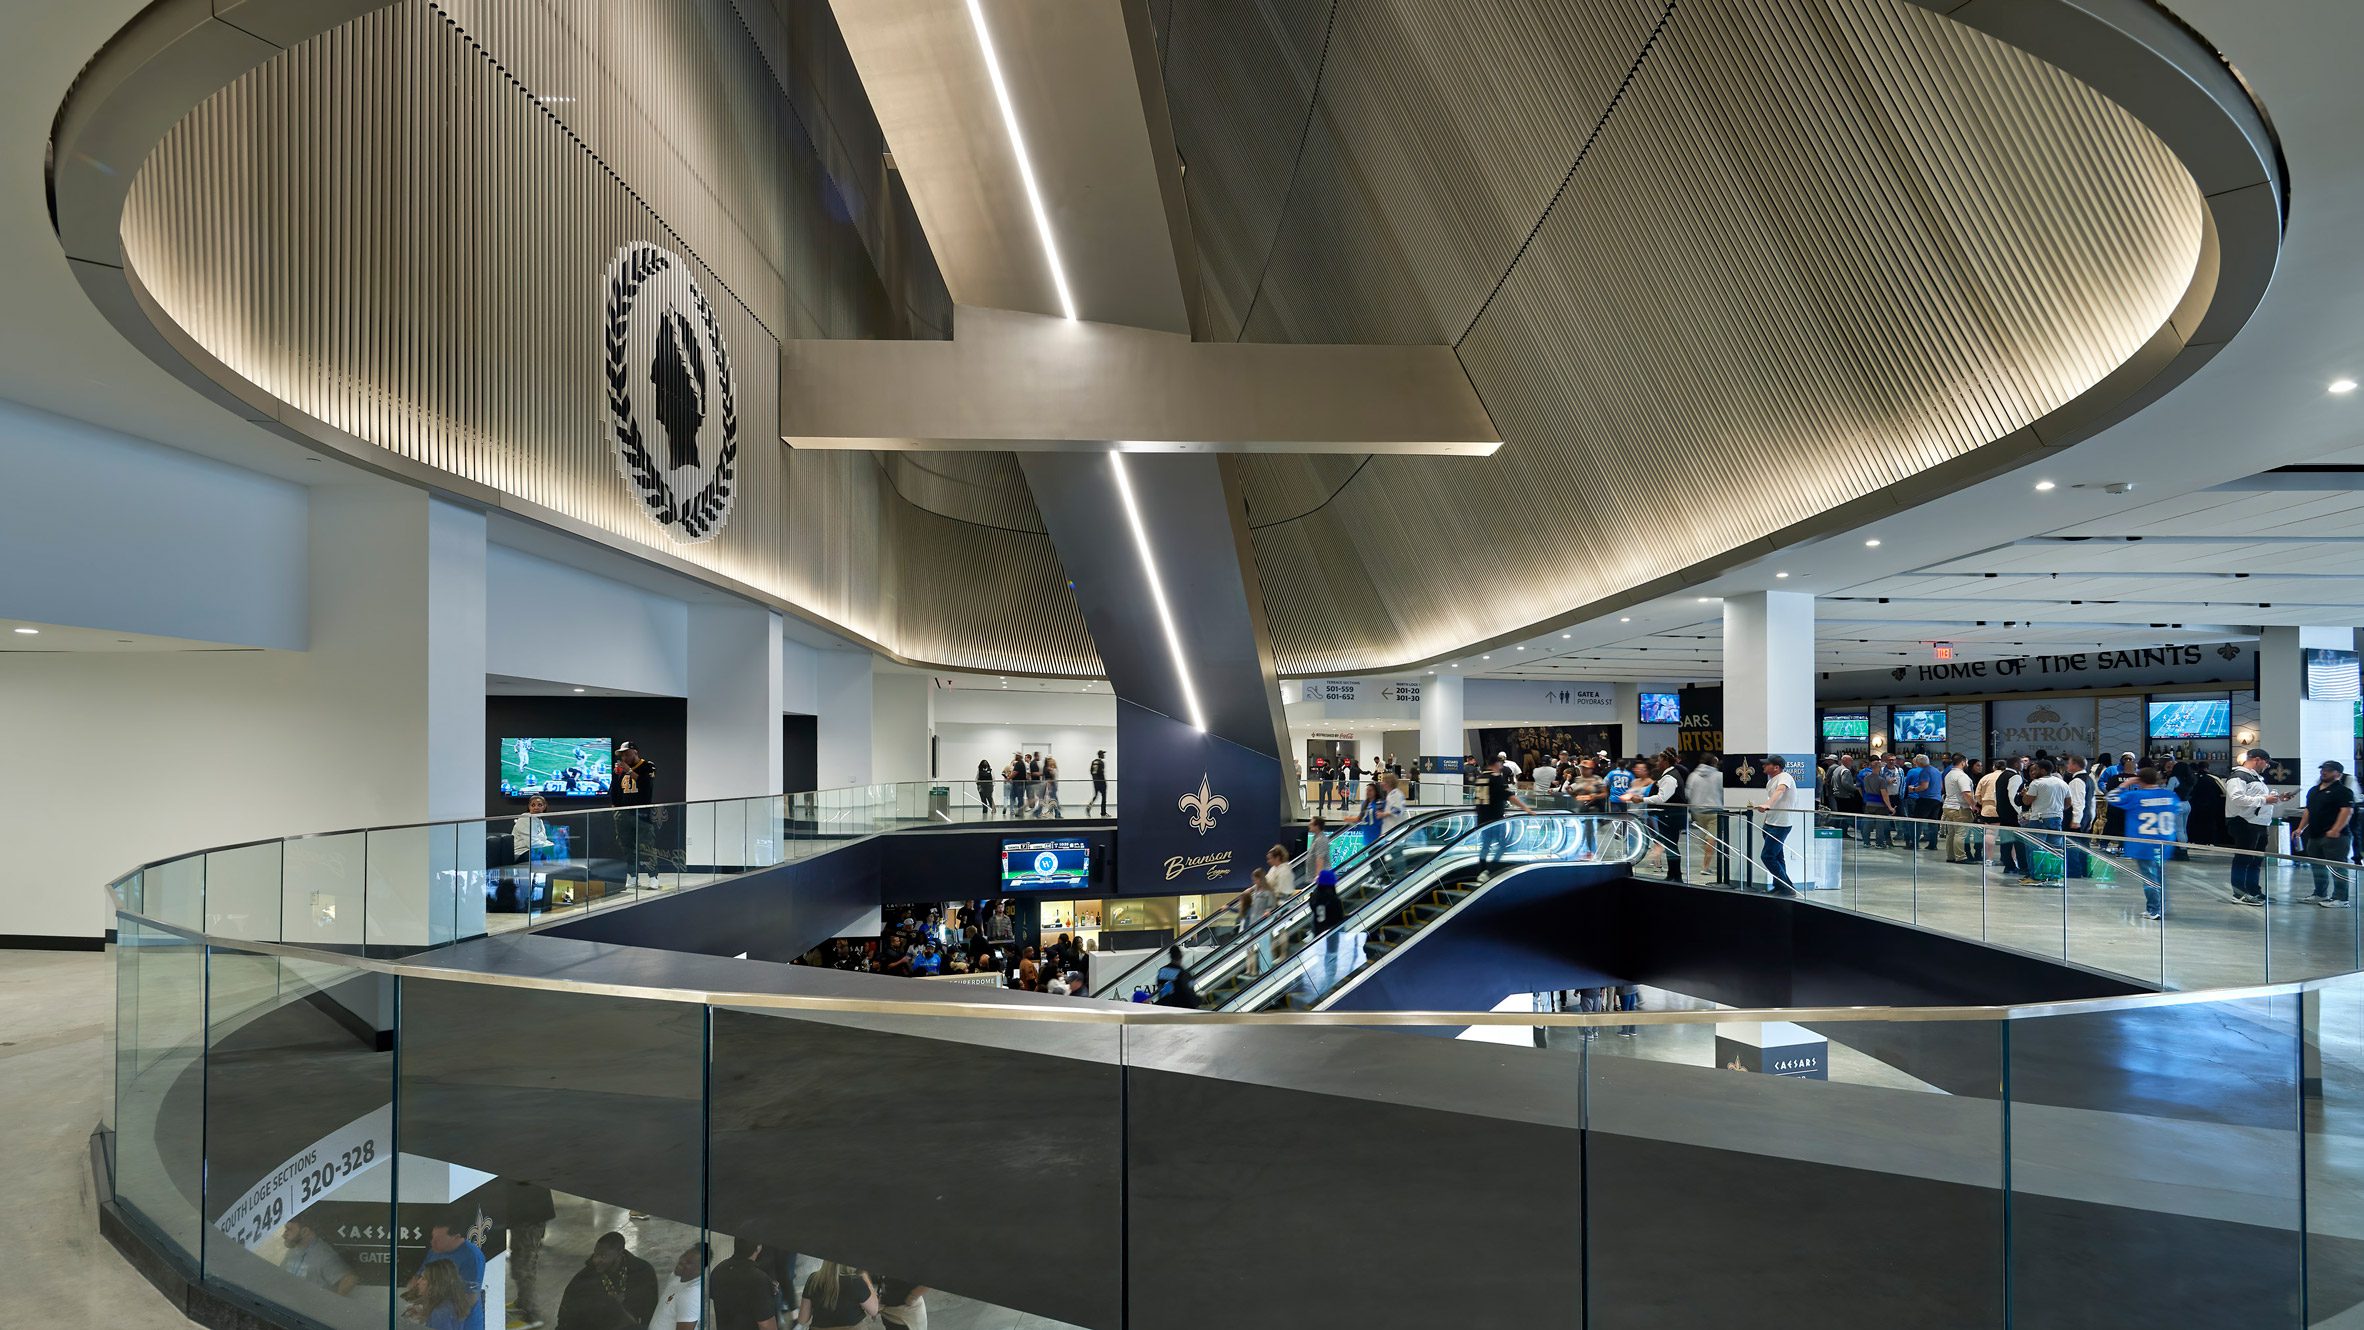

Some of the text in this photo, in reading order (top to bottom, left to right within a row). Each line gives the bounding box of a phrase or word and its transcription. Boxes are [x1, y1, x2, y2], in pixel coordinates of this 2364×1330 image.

[1919, 663, 1987, 682] HOME
[1996, 657, 2027, 676] OF
[2097, 644, 2202, 671] SAINTS
[1326, 685, 1355, 693] 501-559
[1396, 694, 1420, 702] 301-30
[2003, 722, 2086, 742] PATRÓN
[620, 774, 639, 794] 41
[1613, 775, 1629, 788] 20
[2137, 811, 2176, 836] 20
[1163, 850, 1233, 881] Branson
[1774, 1057, 1817, 1071] CAESARS
[248, 1181, 272, 1210] LOGE
[272, 1149, 318, 1191] SECTIONS
[301, 1139, 376, 1203] 320-328
